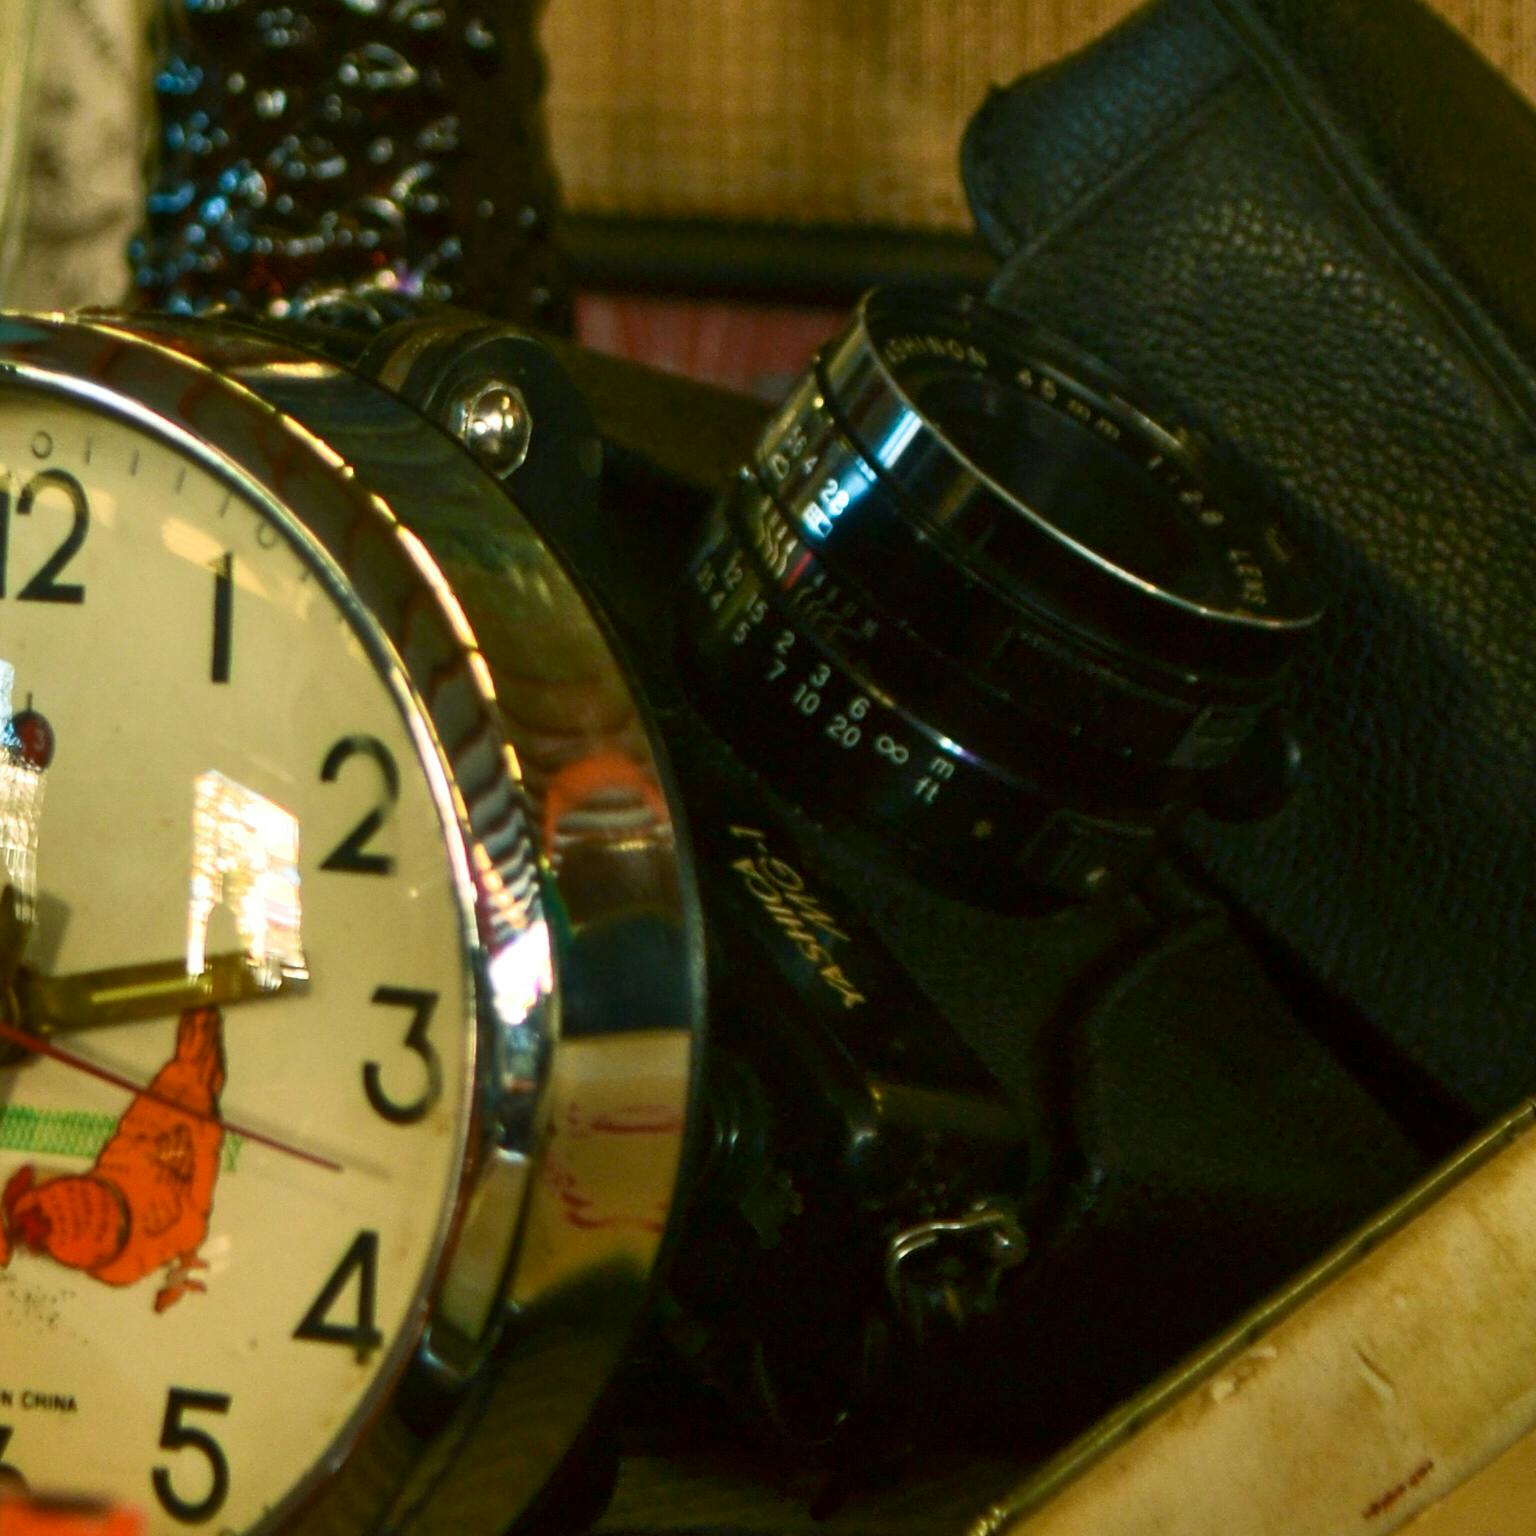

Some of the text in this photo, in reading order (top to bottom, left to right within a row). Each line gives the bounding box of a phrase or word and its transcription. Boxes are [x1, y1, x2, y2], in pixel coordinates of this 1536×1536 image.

[208, 551, 232, 683] 1
[792, 683, 822, 718] 10
[825, 712, 862, 751] 20
[809, 664, 832, 690] 3
[848, 696, 871, 722] 6
[320, 735, 400, 875] 2
[733, 856, 867, 1008] YASHICA
[363, 986, 443, 1126] 3
[294, 1229, 384, 1364] 4
[20, 1389, 79, 1413] CHINA
[151, 1389, 232, 1525] 5
